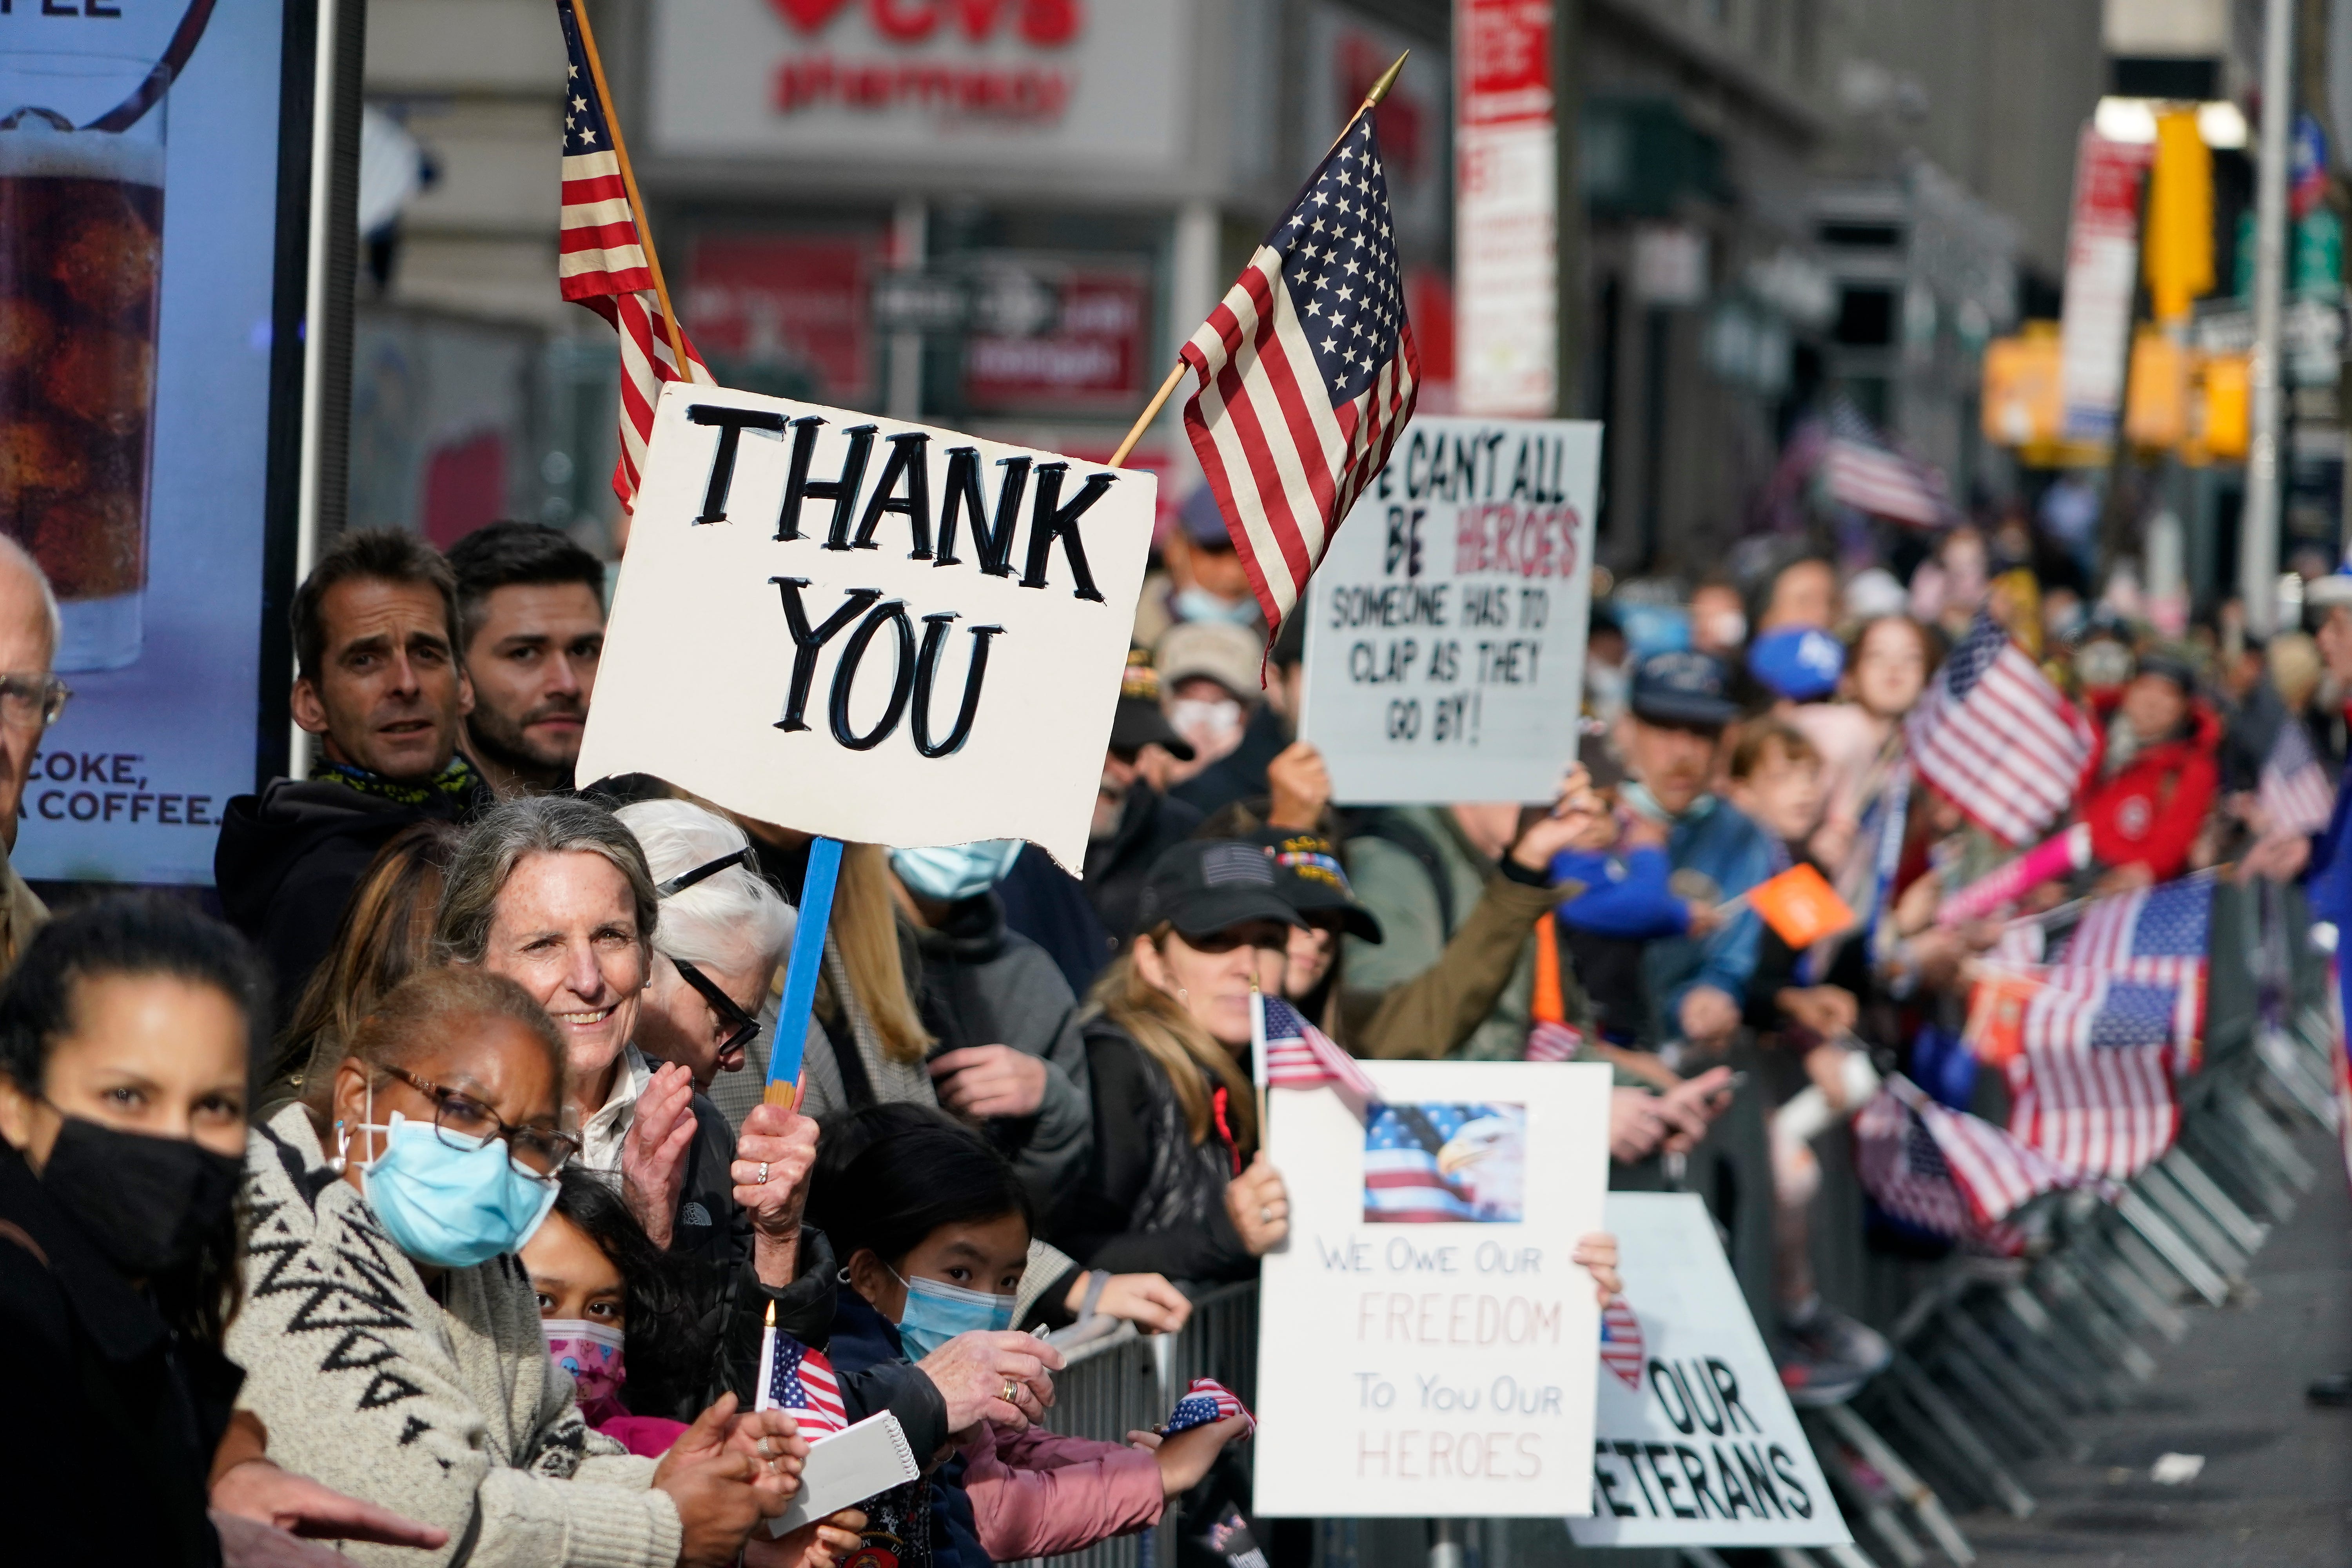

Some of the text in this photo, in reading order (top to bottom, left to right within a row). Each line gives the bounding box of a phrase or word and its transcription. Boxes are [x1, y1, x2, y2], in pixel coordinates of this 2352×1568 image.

[1508, 434, 1565, 504] ALL
[686, 404, 1120, 606] THANK
[1385, 502, 1581, 578] BE HEROES
[1331, 583, 1550, 630] SOMEONE HAS TO
[768, 577, 1007, 759] YOU
[1348, 637, 1543, 684] CLAP AS THEY
[1386, 688, 1483, 746] GO BY!
[38, 789, 221, 825] COFFEE.
[1357, 1291, 1563, 1345] FREEDOM
[1647, 1355, 1763, 1436] OUR
[1357, 1429, 1543, 1479] HEROES
[1594, 1439, 1813, 1519] ETERANS
